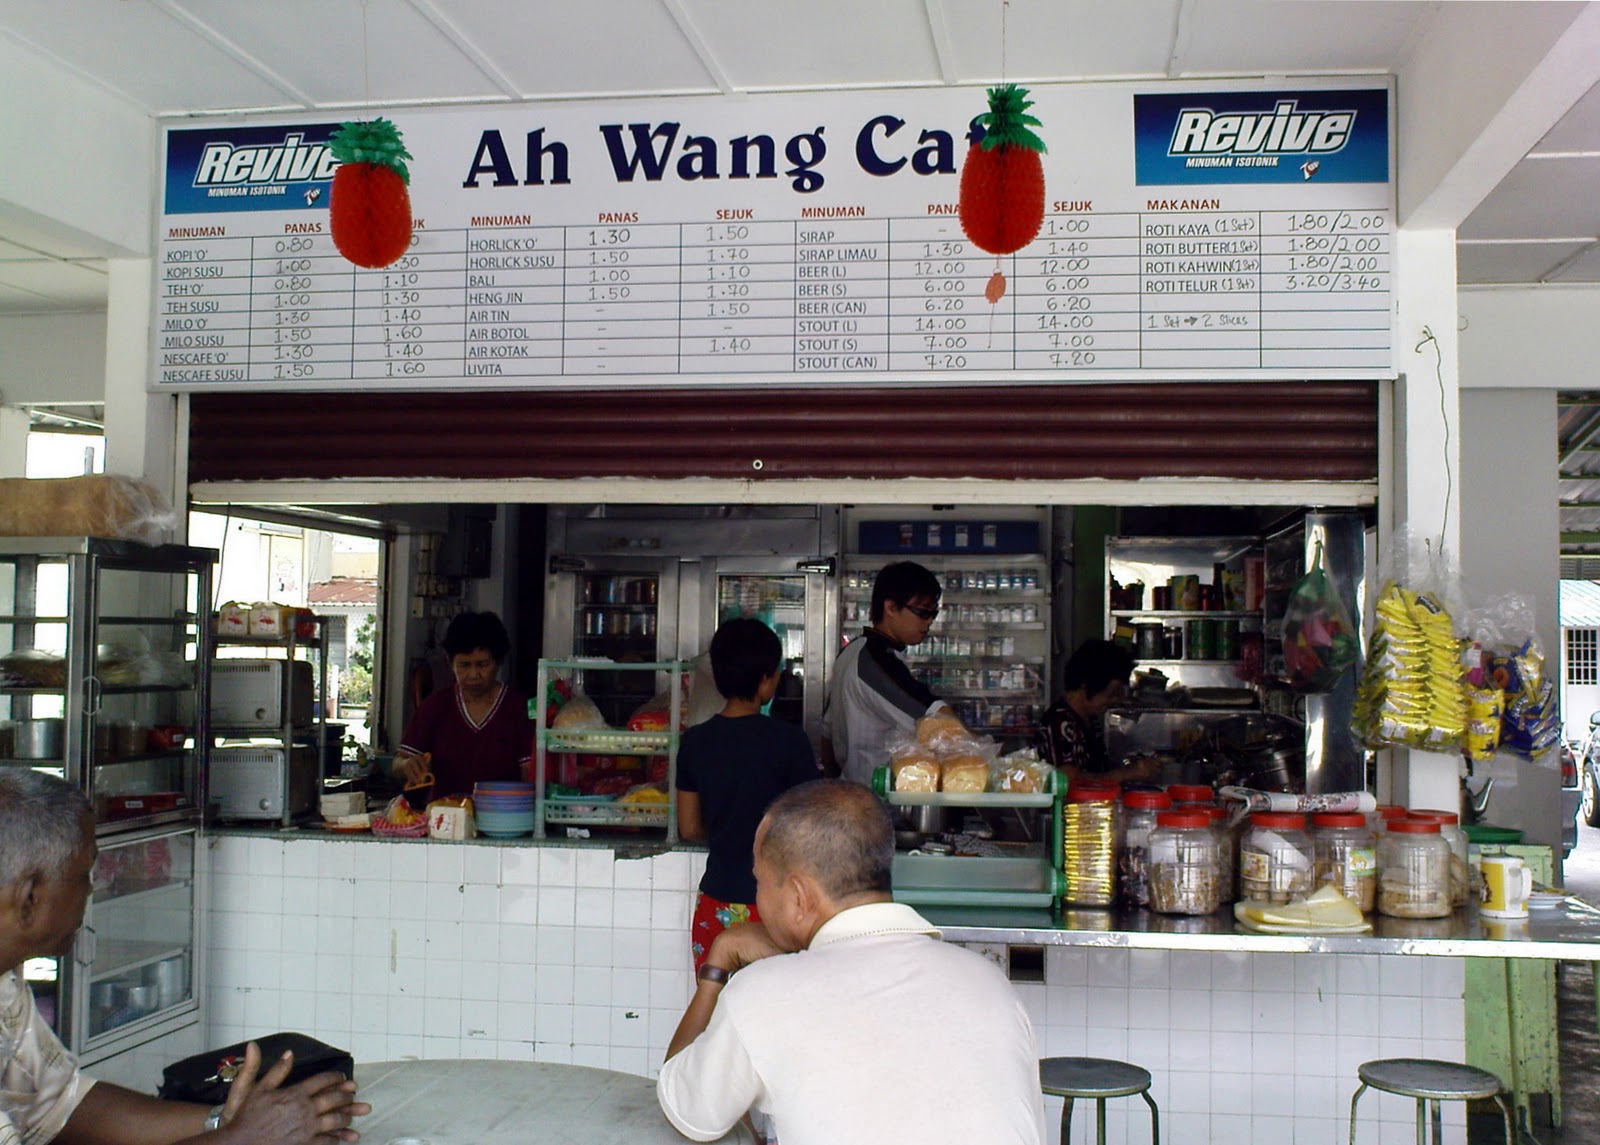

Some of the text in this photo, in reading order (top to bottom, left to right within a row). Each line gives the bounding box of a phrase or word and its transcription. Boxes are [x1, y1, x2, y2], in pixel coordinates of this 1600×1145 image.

[1167, 100, 1358, 156] Revive
[462, 112, 989, 193] Ah Wang Ca
[1186, 156, 1279, 168] MINUMAN ISOTONIK
[207, 186, 286, 197] MINUMAN ISOTONIK
[928, 204, 960, 215] PANA
[1053, 201, 1093, 212] SEJUK
[1147, 200, 1220, 210] MAKANAN
[598, 213, 639, 223] PANAS
[716, 209, 753, 220] SEJUK
[801, 207, 865, 218] MINUMAN
[284, 222, 322, 233] PANAS
[471, 215, 531, 227] MINUMAN
[1047, 219, 1090, 235] 1.00
[169, 226, 226, 237] MINUMAN
[705, 226, 749, 242] 1.50
[1146, 224, 1210, 236] ROTI KAYA
[588, 229, 631, 246] 1.30
[800, 232, 834, 243] SIRAP
[275, 238, 313, 253] 0.80
[470, 240, 521, 250] HORLICK
[923, 243, 963, 257] 1.30
[1049, 242, 1089, 255] 1.40
[1146, 242, 1228, 254] ROTI BUTTER
[167, 251, 193, 261] KOPI
[588, 251, 629, 265] 1.50
[707, 249, 749, 262] 1.70
[799, 249, 877, 261] SIRAP LIMAU
[276, 260, 311, 272] 1.00
[384, 256, 420, 270] .30
[470, 256, 555, 268] HORLICK SUSU
[1040, 259, 1090, 275] 12.00
[1146, 261, 1232, 273] ROTI KAHWIN
[166, 266, 223, 278] KOPI SUSU
[707, 266, 750, 280] 1.10
[799, 267, 847, 279] BEER (L)
[915, 262, 965, 276] 12.00
[385, 274, 418, 288] 1.10
[470, 276, 495, 286] BALI
[589, 270, 630, 283] 1.00
[167, 285, 188, 295] TEH
[274, 278, 312, 289] 0.80
[924, 281, 965, 293] 6.00
[1046, 277, 1089, 291] 6.00
[1146, 280, 1217, 292] ROTI TELUR
[588, 287, 630, 301] 1.50
[707, 285, 749, 298] 1.70
[799, 284, 847, 297] BEER (S)
[274, 295, 310, 308] 1.00
[384, 292, 420, 305] 1.30
[470, 292, 523, 304] HENG JIN
[1046, 297, 1091, 311] 6.20
[167, 302, 219, 312] TEH SUSU
[707, 303, 750, 317] 1.50
[799, 302, 867, 315] BEER (CAN)
[925, 299, 964, 312] 6.20
[274, 312, 310, 325] 1.30
[384, 310, 421, 323] 1.40
[469, 311, 509, 321] AIR TIN
[1038, 315, 1094, 330] 14.00
[166, 319, 194, 329] MILO
[799, 320, 857, 333] STOUT (L)
[915, 318, 966, 332] 14.00
[274, 329, 312, 343] 1.50
[385, 327, 423, 341] 1.60
[469, 328, 529, 339] AIR BOTOL
[165, 336, 224, 347] MILO SUSU
[709, 338, 751, 353] 1.40
[799, 339, 858, 351] STOUT (S)
[924, 336, 967, 350] 7.00
[1049, 334, 1094, 347] 7.00
[274, 346, 313, 359] 1.30
[385, 344, 424, 357] 1.40
[469, 346, 529, 357] AIR KOTAK
[164, 354, 213, 364] NESCAFE
[799, 357, 877, 370] STOUT (CAN)
[924, 355, 966, 369] 7.20
[1049, 352, 1095, 367] 7.20
[163, 370, 244, 381] NESCAFE SUSU
[274, 363, 314, 379] 1.50
[386, 362, 425, 376] 1.60
[468, 364, 502, 375] LIVITA
